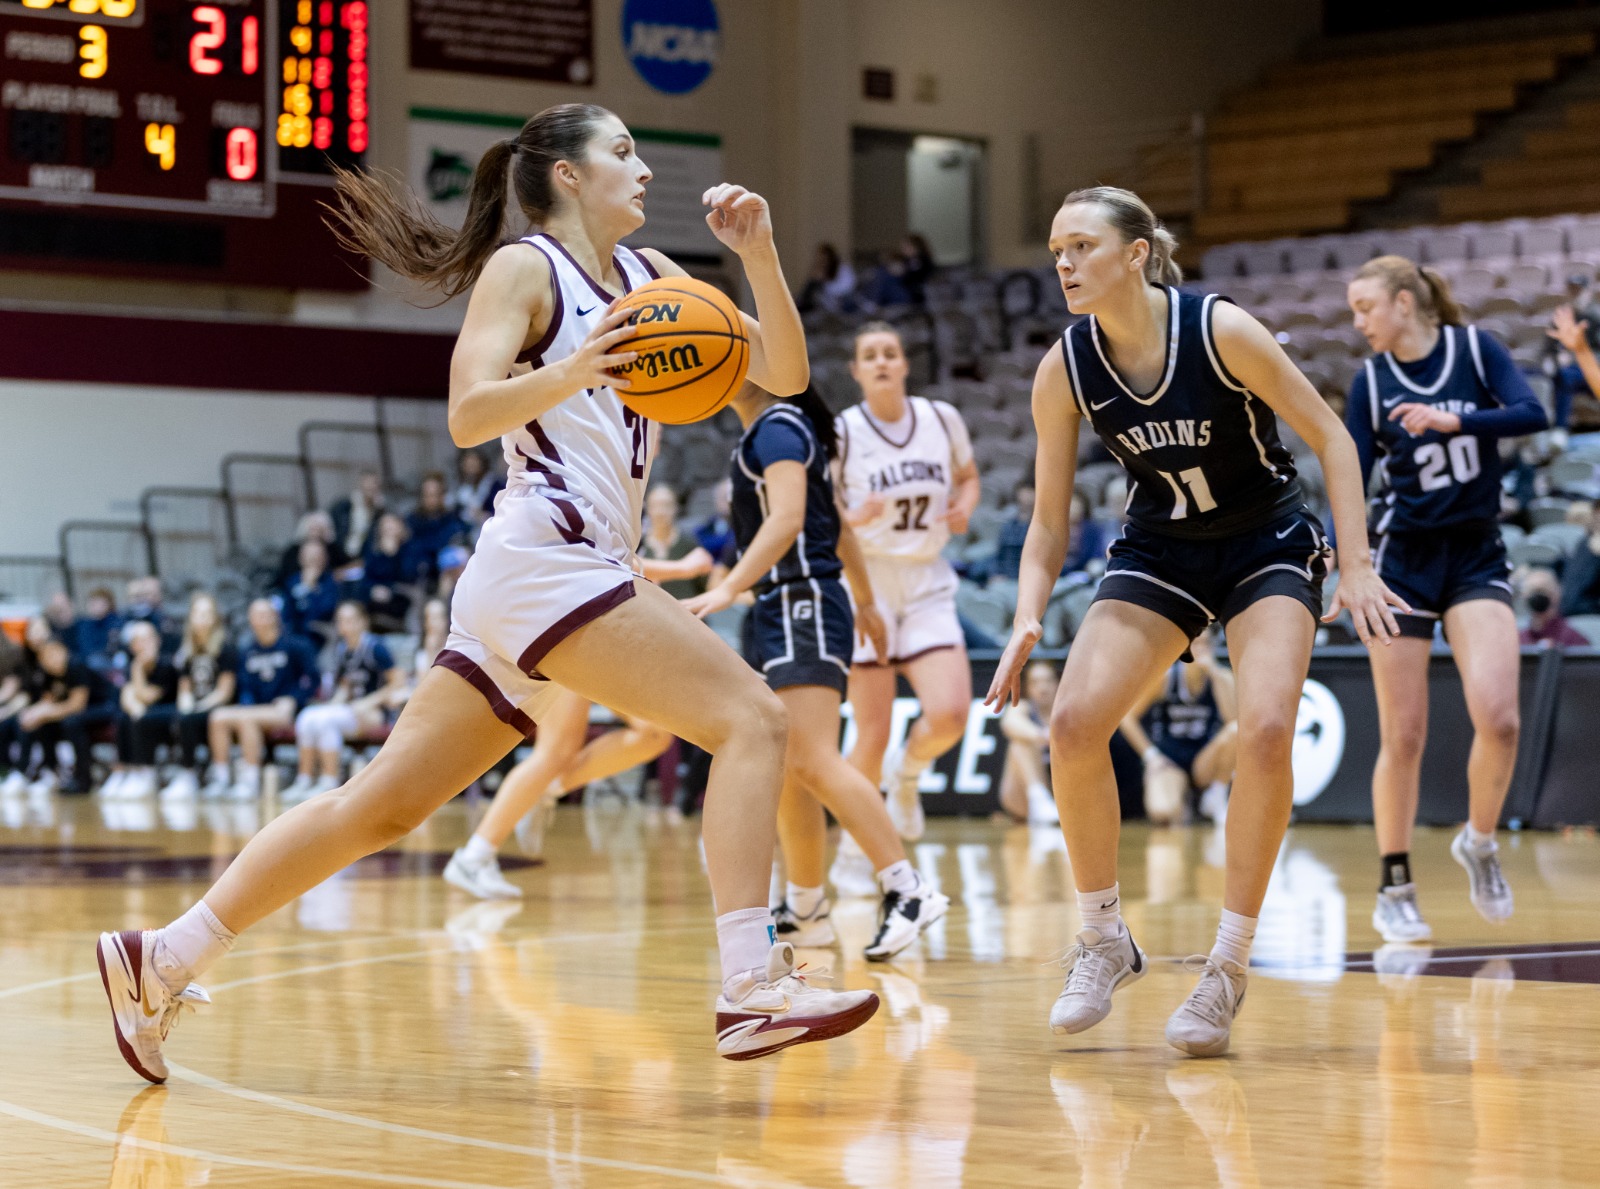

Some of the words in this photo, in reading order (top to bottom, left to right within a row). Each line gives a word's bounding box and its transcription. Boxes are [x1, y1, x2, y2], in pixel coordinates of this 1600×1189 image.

[80, 25, 108, 79] 3
[189, 6, 259, 75] 21
[145, 123, 175, 171] 4
[226, 127, 257, 180] 0
[1116, 420, 1212, 455] BRUINS
[1413, 434, 1480, 491] 20
[893, 495, 930, 531] 32
[1157, 466, 1218, 520] 11
